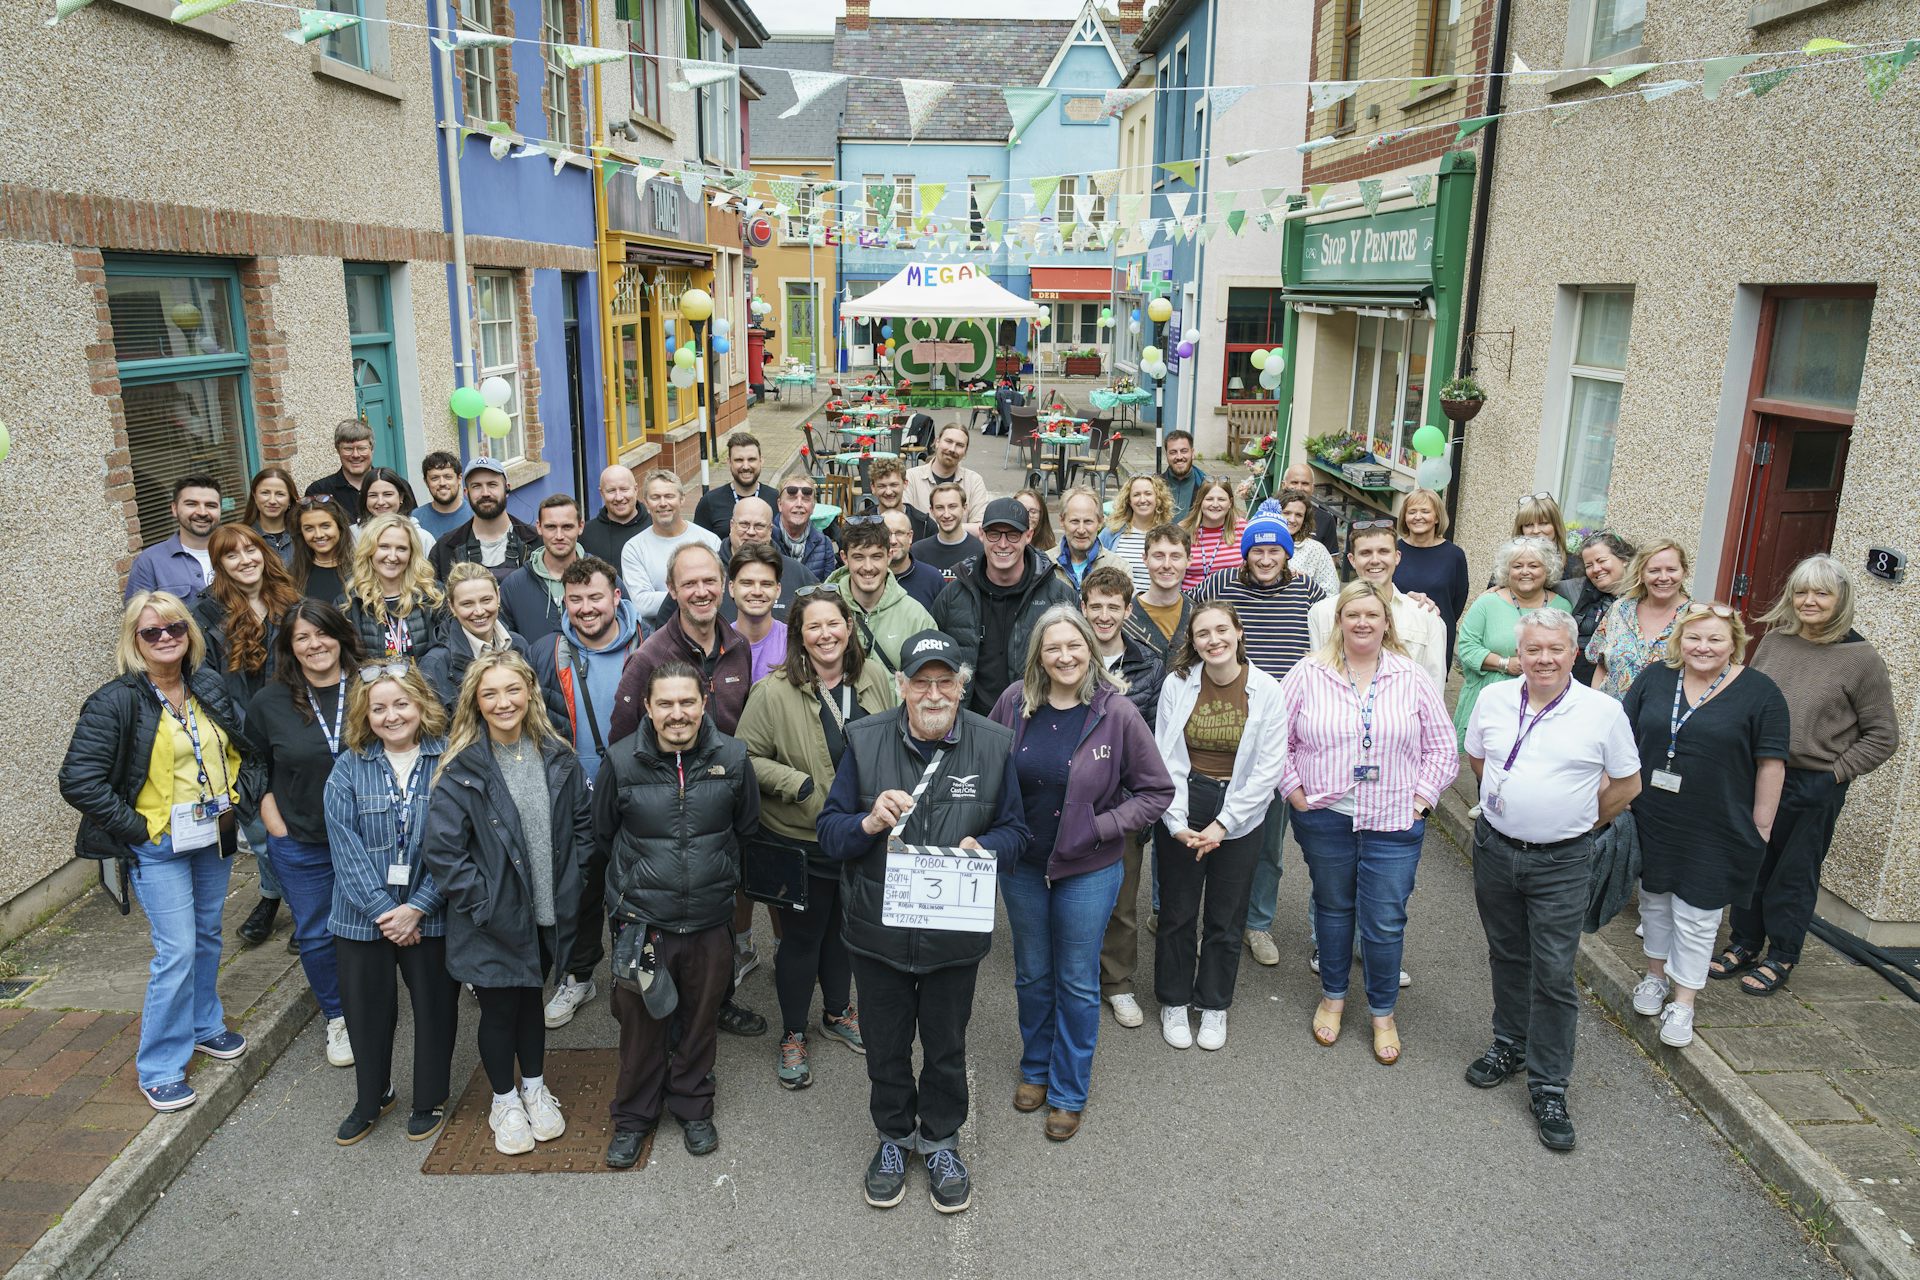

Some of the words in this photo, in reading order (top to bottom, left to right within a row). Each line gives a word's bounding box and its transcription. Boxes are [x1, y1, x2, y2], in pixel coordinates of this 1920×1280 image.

[652, 183, 680, 233] TAMED
[1321, 233, 1347, 266] SIOP
[1350, 229, 1362, 264] Y
[1362, 227, 1418, 263] PENTRE
[907, 264, 991, 287] MEGAN
[1877, 552, 1888, 571] 8
[912, 638, 943, 655] ARRI
[1197, 726, 1243, 741] LAUNDR
[914, 856, 949, 868] POBOL
[954, 859, 961, 870] Y
[966, 860, 995, 873] CWM
[923, 877, 943, 900] 3
[971, 877, 978, 903] 1
[896, 914, 929, 924] 12/6/24
